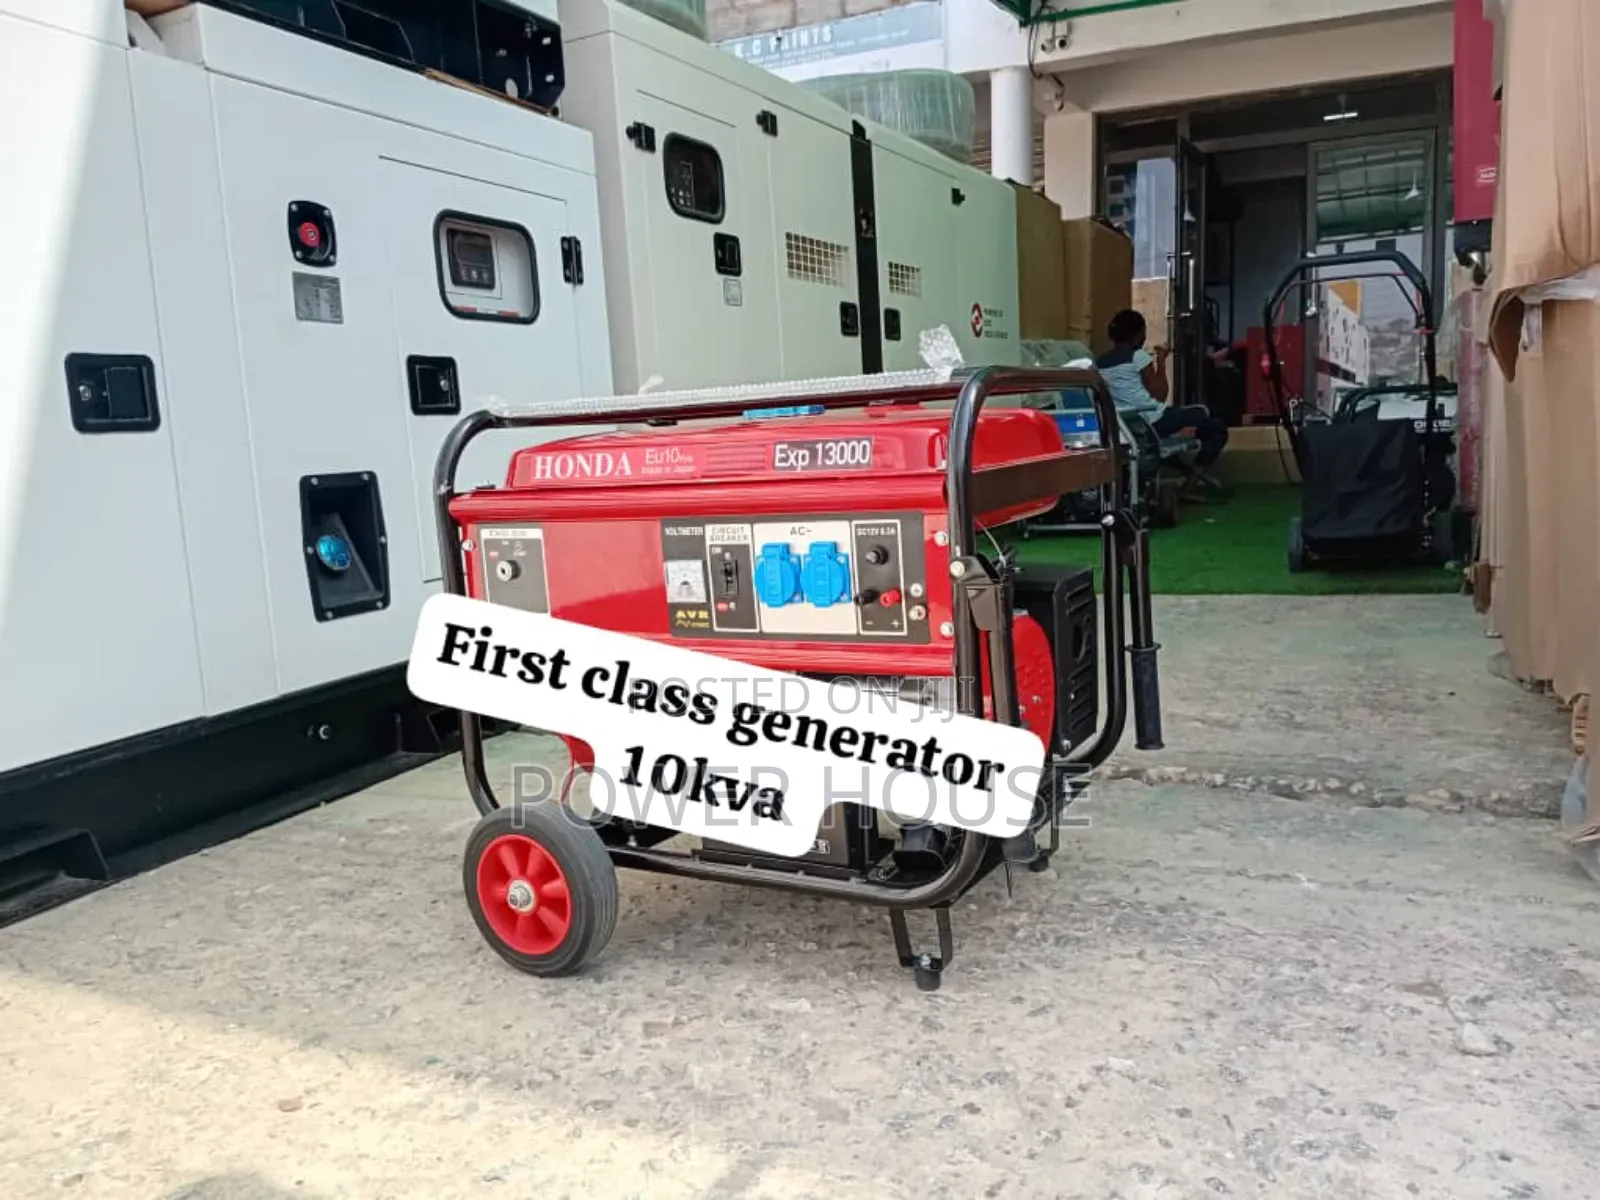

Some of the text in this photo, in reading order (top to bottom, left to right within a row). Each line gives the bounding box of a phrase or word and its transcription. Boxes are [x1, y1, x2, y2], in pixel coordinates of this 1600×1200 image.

[769, 24, 832, 53] PAINTS
[533, 452, 632, 480] HONDA
[774, 439, 871, 472] Exp 13000
[675, 609, 710, 620] AVR
